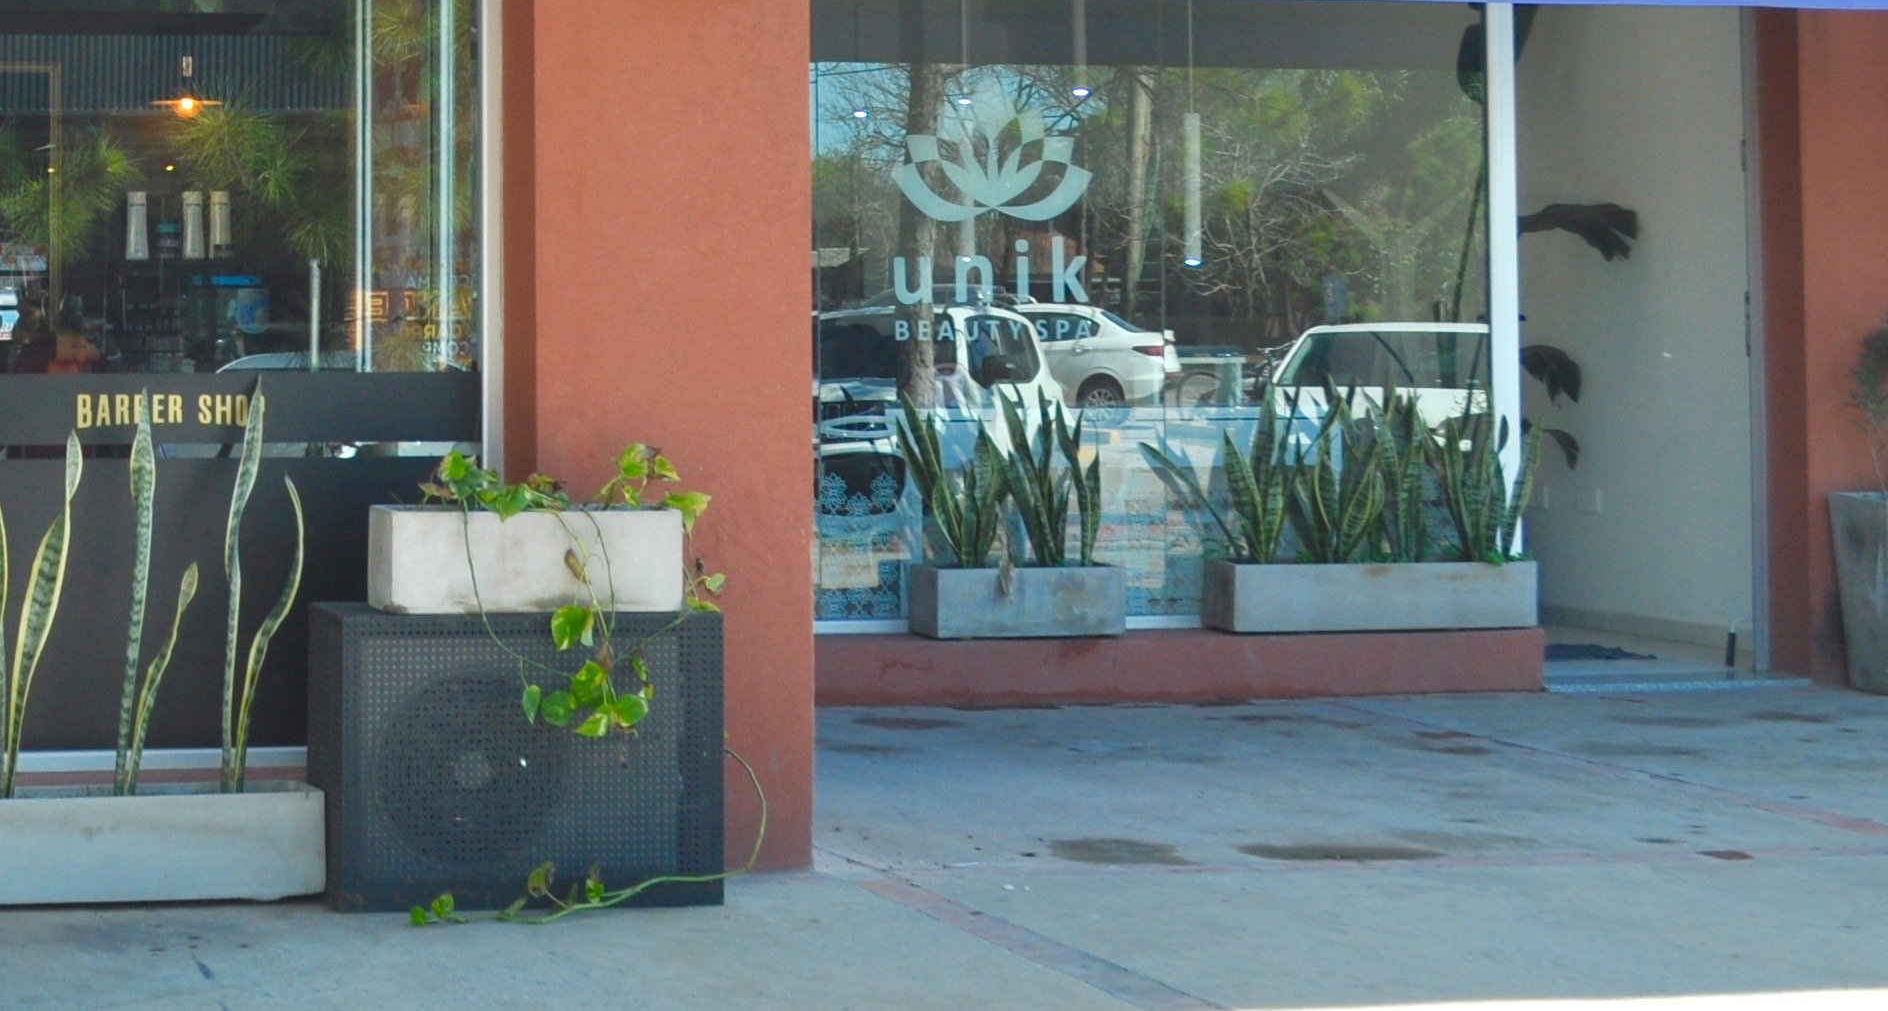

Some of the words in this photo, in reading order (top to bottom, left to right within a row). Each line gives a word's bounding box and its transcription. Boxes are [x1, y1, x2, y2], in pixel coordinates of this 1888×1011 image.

[893, 235, 1091, 305] unik
[894, 319, 1023, 342] BEAUTY
[1035, 318, 1092, 340] SPA
[197, 393, 266, 427] SHO
